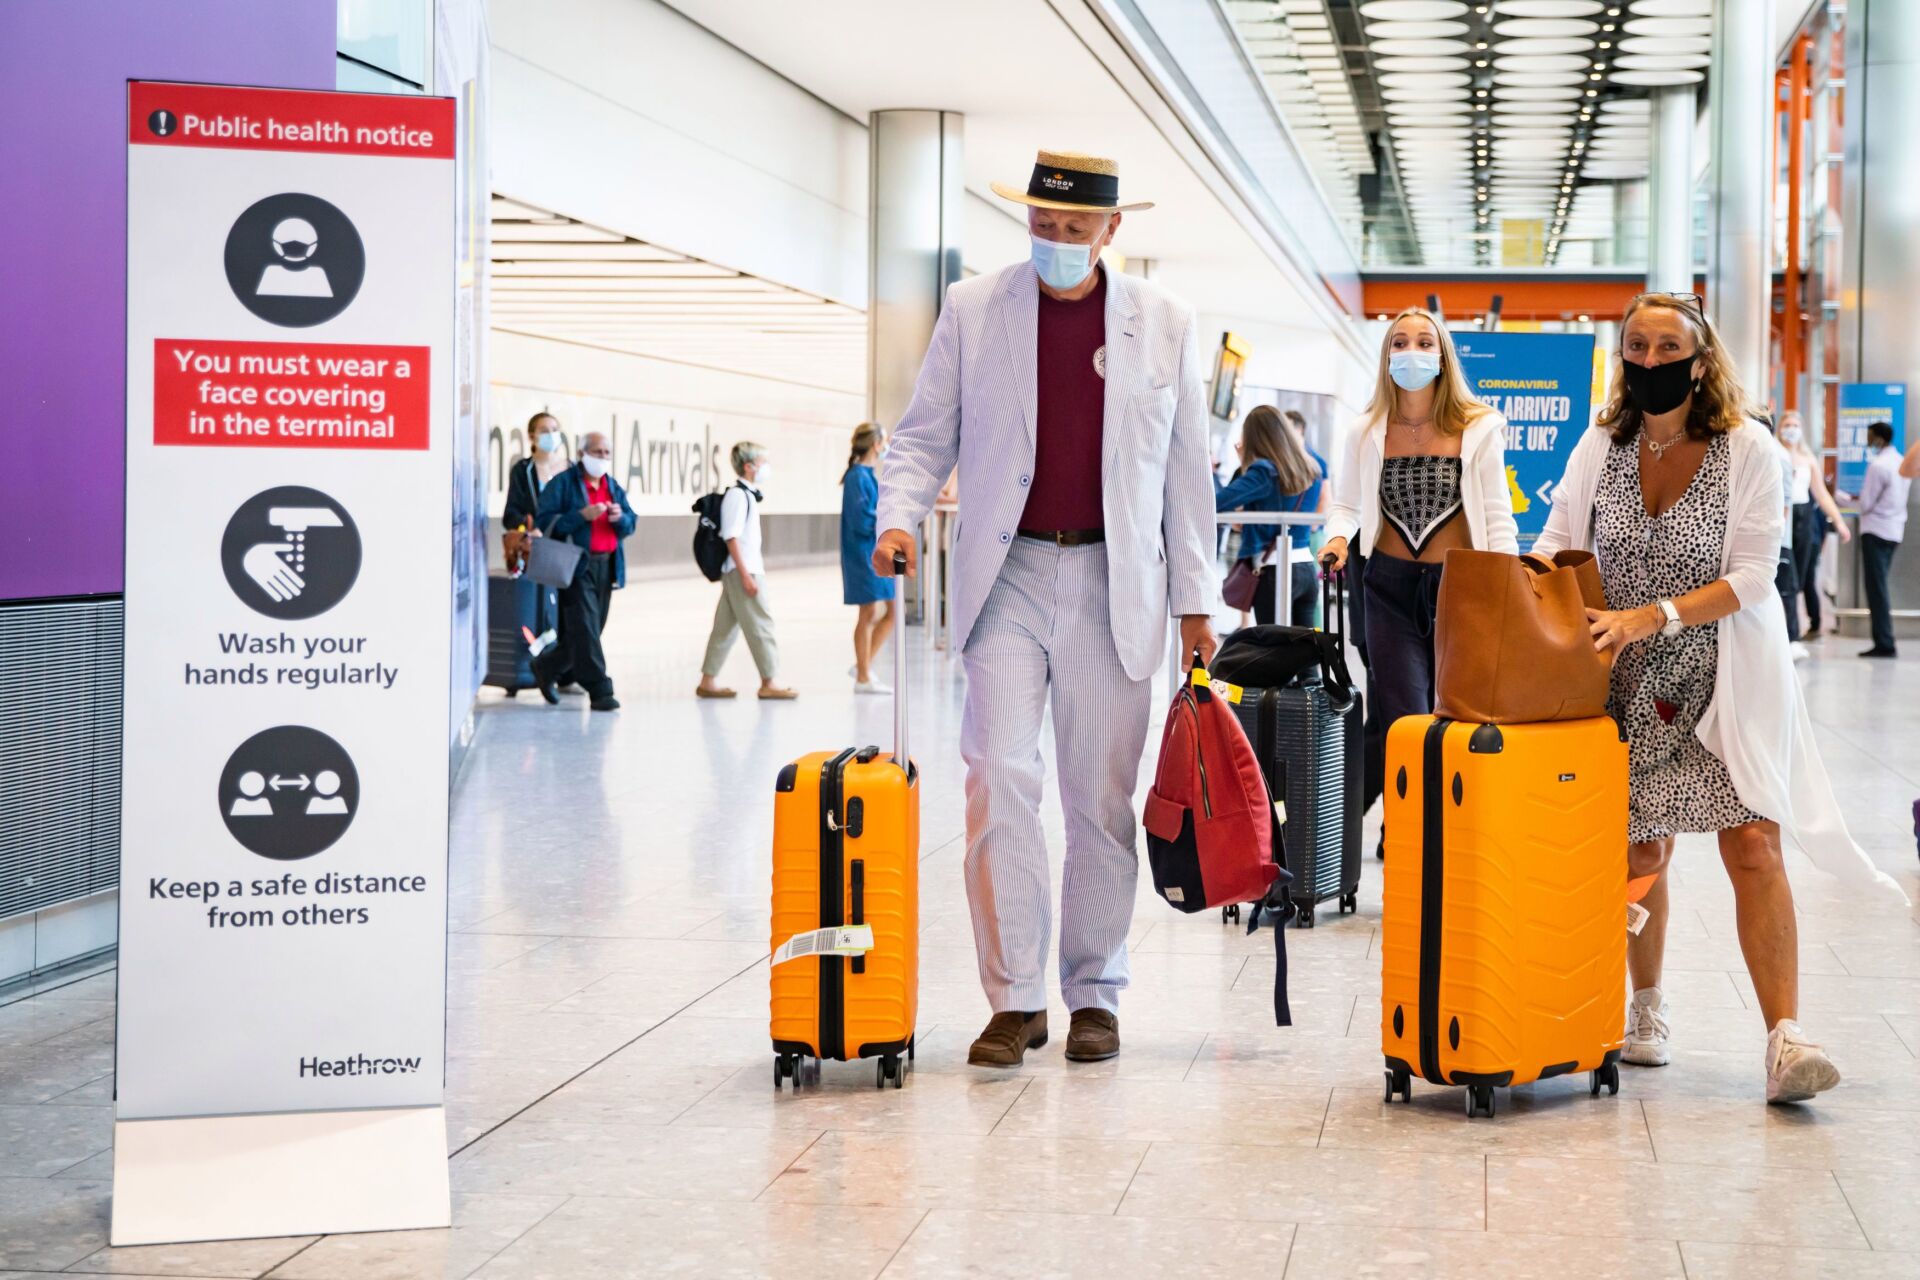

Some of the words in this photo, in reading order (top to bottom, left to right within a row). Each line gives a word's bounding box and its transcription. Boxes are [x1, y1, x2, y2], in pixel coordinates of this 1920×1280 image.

[184, 115, 261, 139] Public
[268, 119, 349, 143] health
[356, 122, 433, 147] notice
[1043, 177, 1073, 187] LONDON
[174, 349, 230, 373] You
[239, 353, 310, 376] must
[316, 357, 388, 377] wear
[395, 360, 410, 378] a
[199, 381, 257, 405] face
[265, 383, 386, 413] covering
[1478, 379, 1559, 389] CORONAVIRUS
[1504, 396, 1570, 421] ARRIVED
[189, 411, 215, 434] in
[223, 412, 270, 436] the
[277, 414, 394, 438] terminal
[1527, 426, 1558, 451] UK?
[626, 419, 720, 496] Arrivals
[218, 633, 295, 653] Wash
[303, 637, 367, 659] your
[185, 664, 268, 684] hands
[277, 663, 398, 689] regularly
[149, 878, 220, 903] Keep
[227, 881, 243, 897] a
[251, 874, 307, 896] safe
[314, 873, 426, 895] distance
[207, 906, 274, 927] from
[281, 904, 369, 926] others
[300, 1053, 421, 1078] Heathrow
